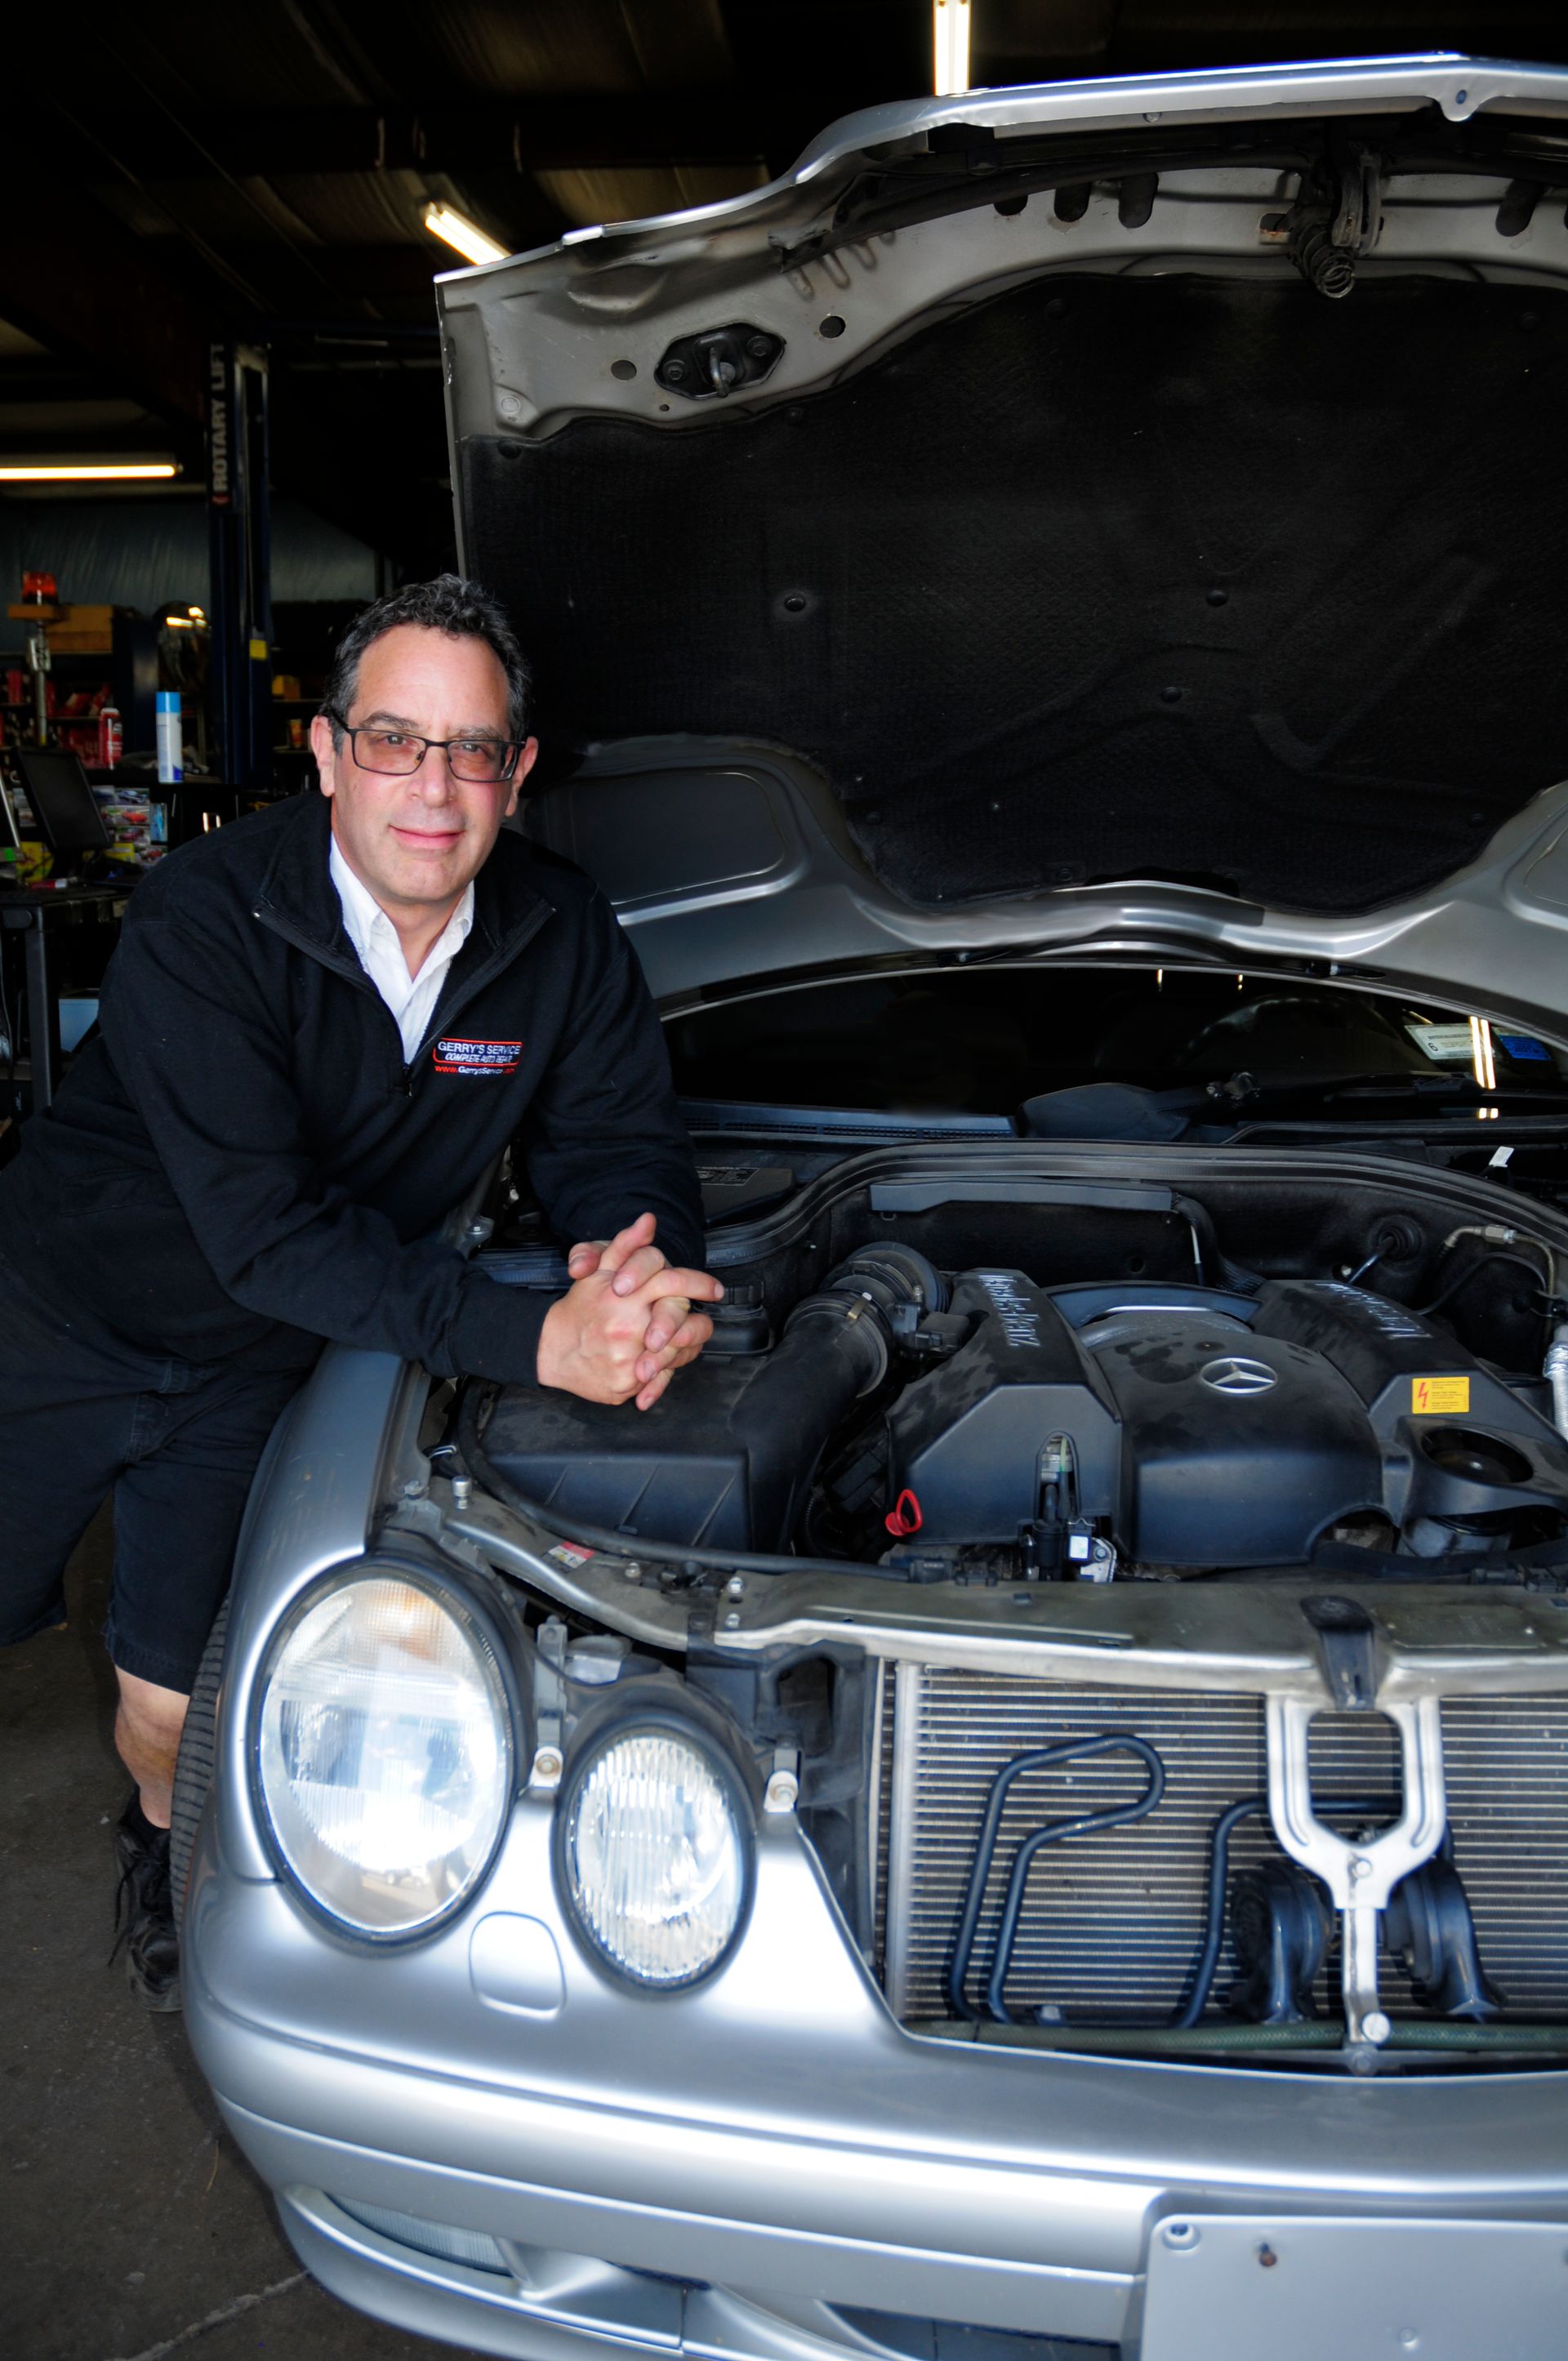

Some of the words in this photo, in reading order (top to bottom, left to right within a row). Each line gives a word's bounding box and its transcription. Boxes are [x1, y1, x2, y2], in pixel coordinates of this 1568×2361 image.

[210, 343, 226, 391] LIFT
[211, 399, 228, 492] ROTARY
[438, 1041, 485, 1054] GERRY'S
[486, 1045, 521, 1055] SERVICE
[445, 1053, 481, 1062] COMPLETE
